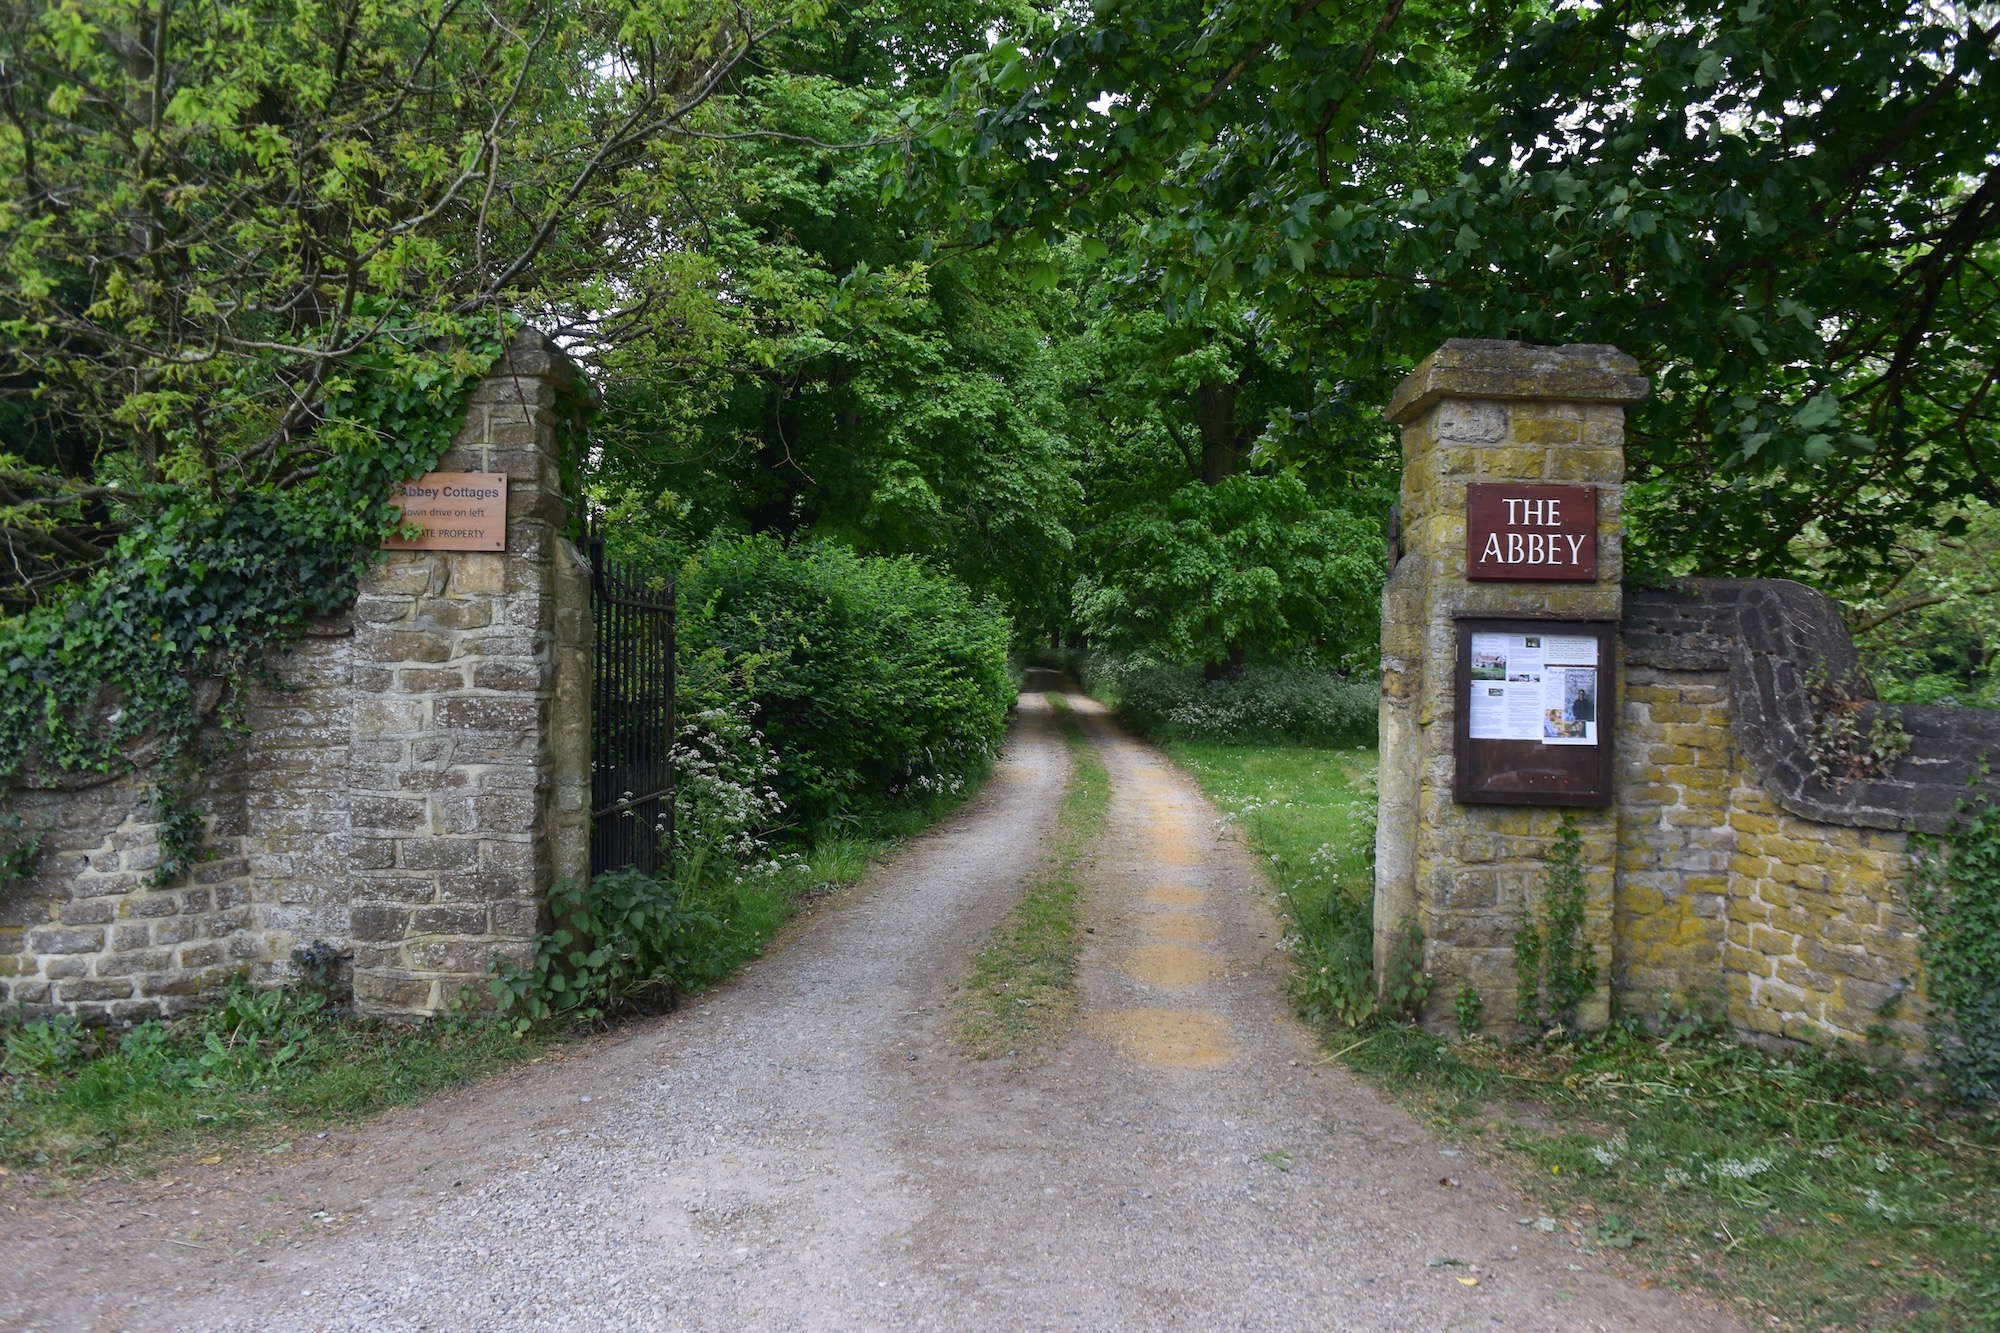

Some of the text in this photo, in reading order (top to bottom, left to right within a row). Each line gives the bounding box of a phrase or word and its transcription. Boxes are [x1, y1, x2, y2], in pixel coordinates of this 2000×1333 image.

[401, 486, 499, 500] Abbey Cottages
[429, 507, 452, 517] drive
[454, 509, 467, 517] on
[469, 507, 485, 517] left
[1502, 498, 1562, 526] THE
[439, 529, 485, 539] PROPERTY
[1479, 532, 1587, 565] ABBEY
